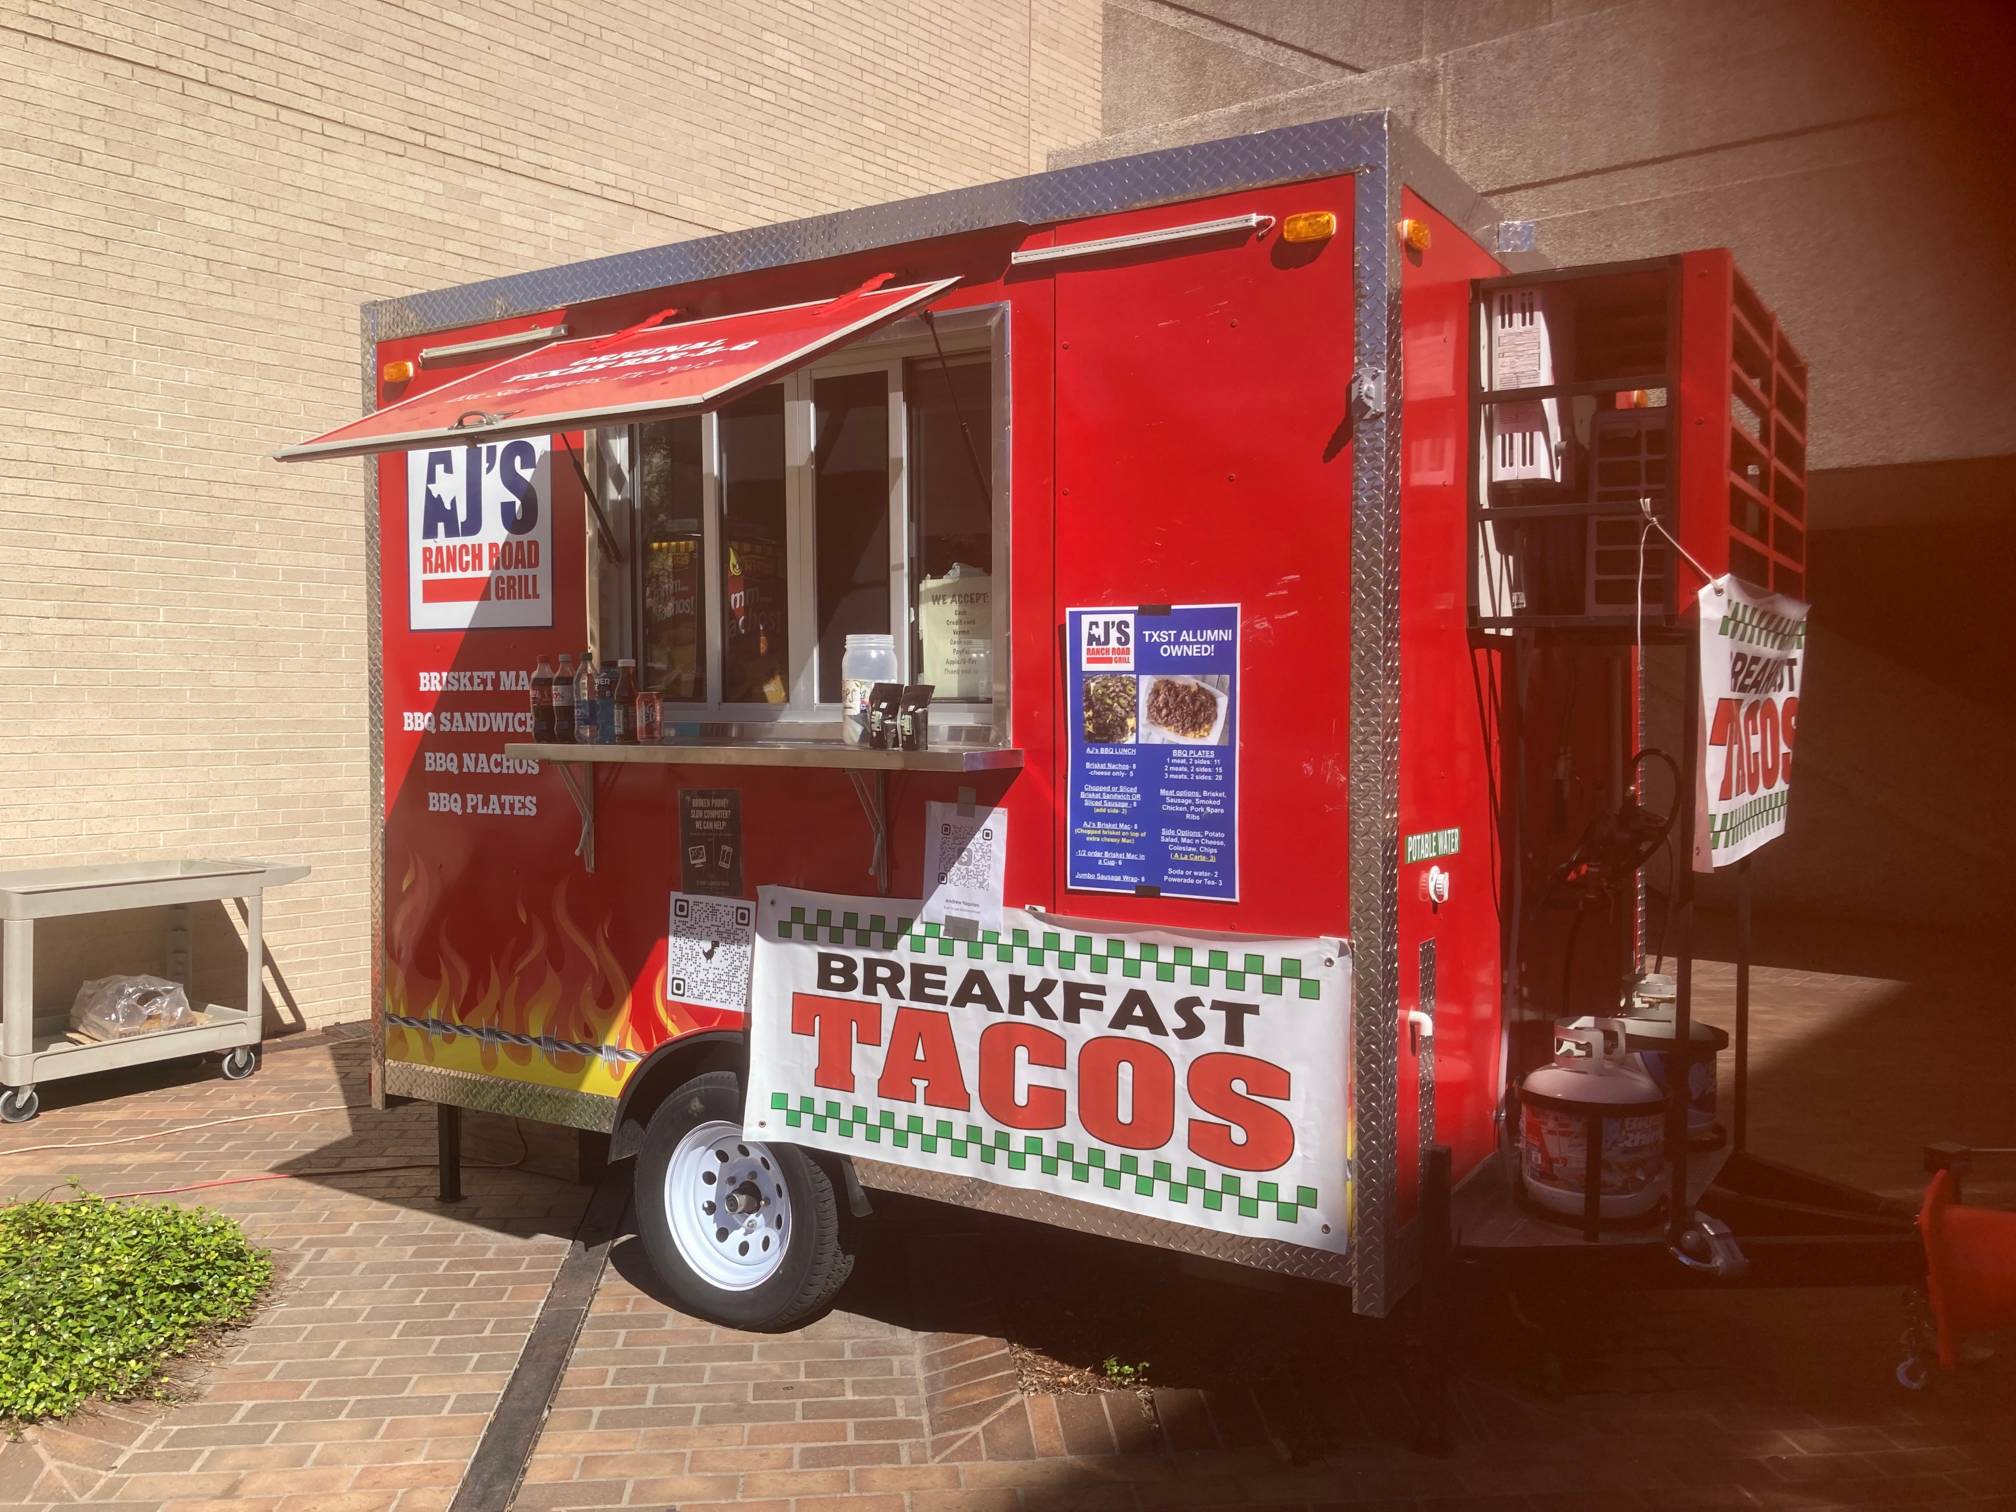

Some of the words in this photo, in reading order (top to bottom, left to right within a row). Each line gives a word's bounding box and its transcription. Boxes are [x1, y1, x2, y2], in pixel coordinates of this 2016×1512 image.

[422, 440, 538, 539] AJ'S
[422, 543, 483, 574] RANCH
[488, 540, 540, 570] ROAD
[494, 574, 540, 600] GRILL
[931, 594, 947, 605] WE
[1086, 620, 1130, 647] AJ'S
[1142, 630, 1177, 643] TXST
[1179, 629, 1233, 642] ALUMNI
[1086, 647, 1111, 656] RANCH
[1111, 647, 1130, 656] ROAD
[1160, 645, 1215, 657] OWNED!
[1113, 656, 1130, 664] GRILL
[418, 671, 495, 692] BRISKET
[499, 671, 532, 691] MA
[403, 712, 436, 734] BBQ
[1100, 747, 1114, 755] BBQ
[1172, 749, 1187, 758] BBQ
[1188, 750, 1215, 758] PLATES
[1709, 697, 1800, 801] TACOS
[424, 752, 459, 774] BBQ
[462, 753, 540, 775] NACHOS
[1085, 762, 1106, 770] Brisket
[1084, 784, 1111, 793] Chopped
[1119, 785, 1138, 793] Sliced
[1160, 788, 1175, 796] Meat
[1080, 791, 1102, 799] Brisket
[1102, 792, 1130, 800] Sandwich
[428, 791, 462, 815] BBQ
[466, 793, 537, 817] PLATES
[1084, 799, 1103, 807] Sliced
[1206, 806, 1225, 814] Spare
[695, 820, 703, 829] WE
[703, 820, 714, 830] CAN
[1097, 821, 1118, 829] Brisket
[1161, 828, 1176, 836] Side
[1204, 830, 1225, 838] Potato
[1199, 846, 1218, 854] Chips
[1408, 832, 1437, 863] POTABLE
[1437, 828, 1459, 855] WATER
[1087, 850, 1103, 858] order
[1104, 851, 1125, 859] Brisket
[1126, 852, 1138, 860] Mac
[1075, 871, 1096, 879] Jumbo
[1096, 873, 1121, 881] Sausage
[1163, 876, 1194, 884] Powerade
[815, 951, 1260, 1047] BREAKFAST
[791, 991, 1295, 1173] TACOS
